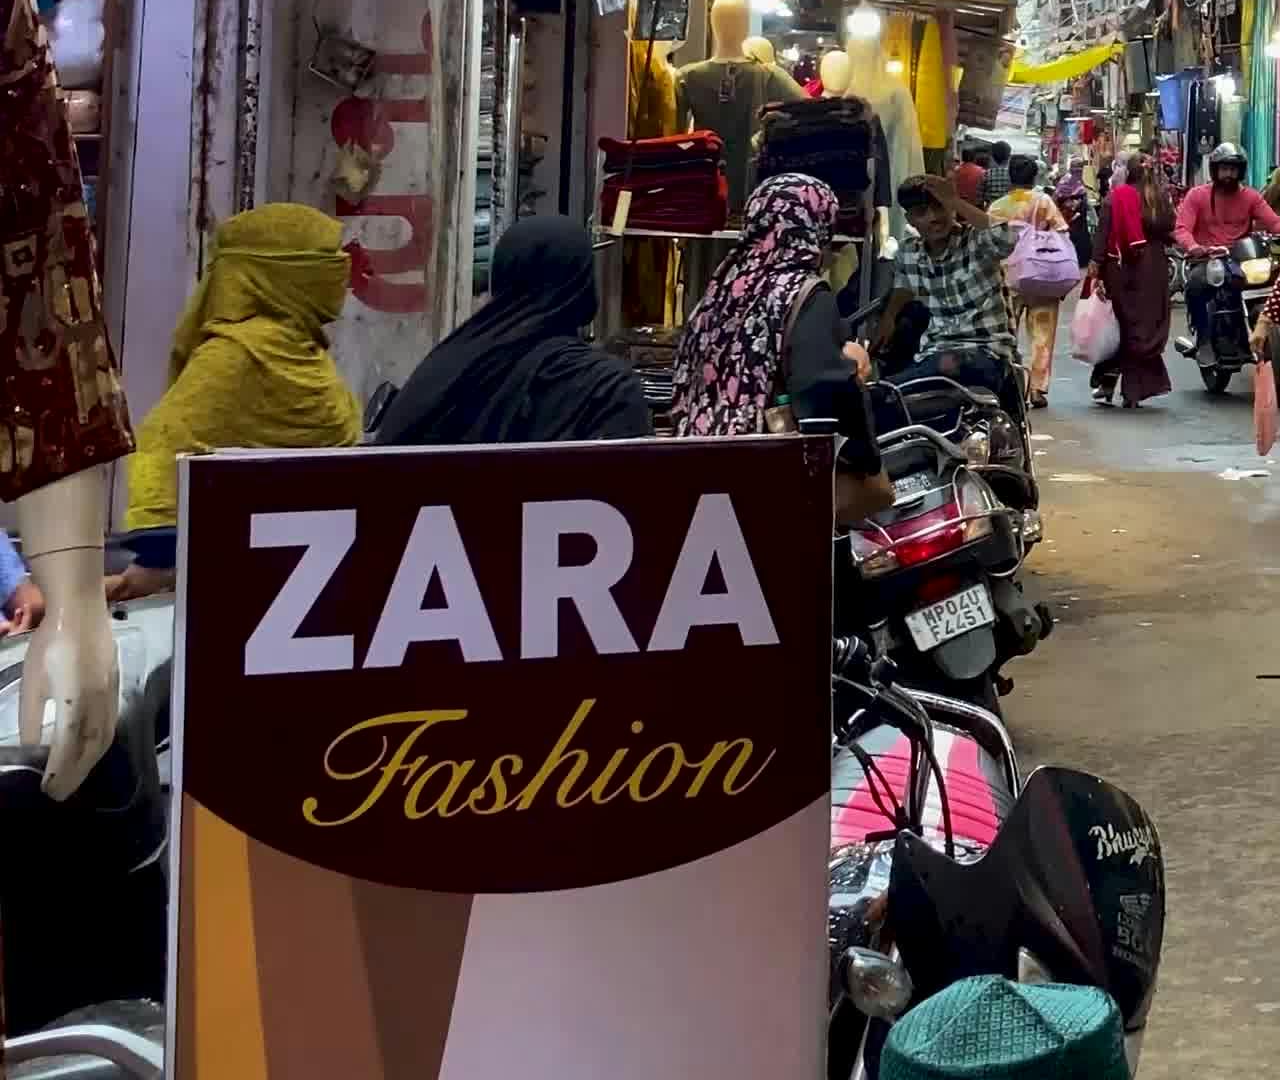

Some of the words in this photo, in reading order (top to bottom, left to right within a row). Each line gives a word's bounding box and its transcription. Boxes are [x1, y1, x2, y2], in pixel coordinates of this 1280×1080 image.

[244, 492, 781, 676] ZARA
[921, 588, 980, 627] MP04U
[929, 604, 987, 642] F4451
[302, 697, 777, 828] Fashion
